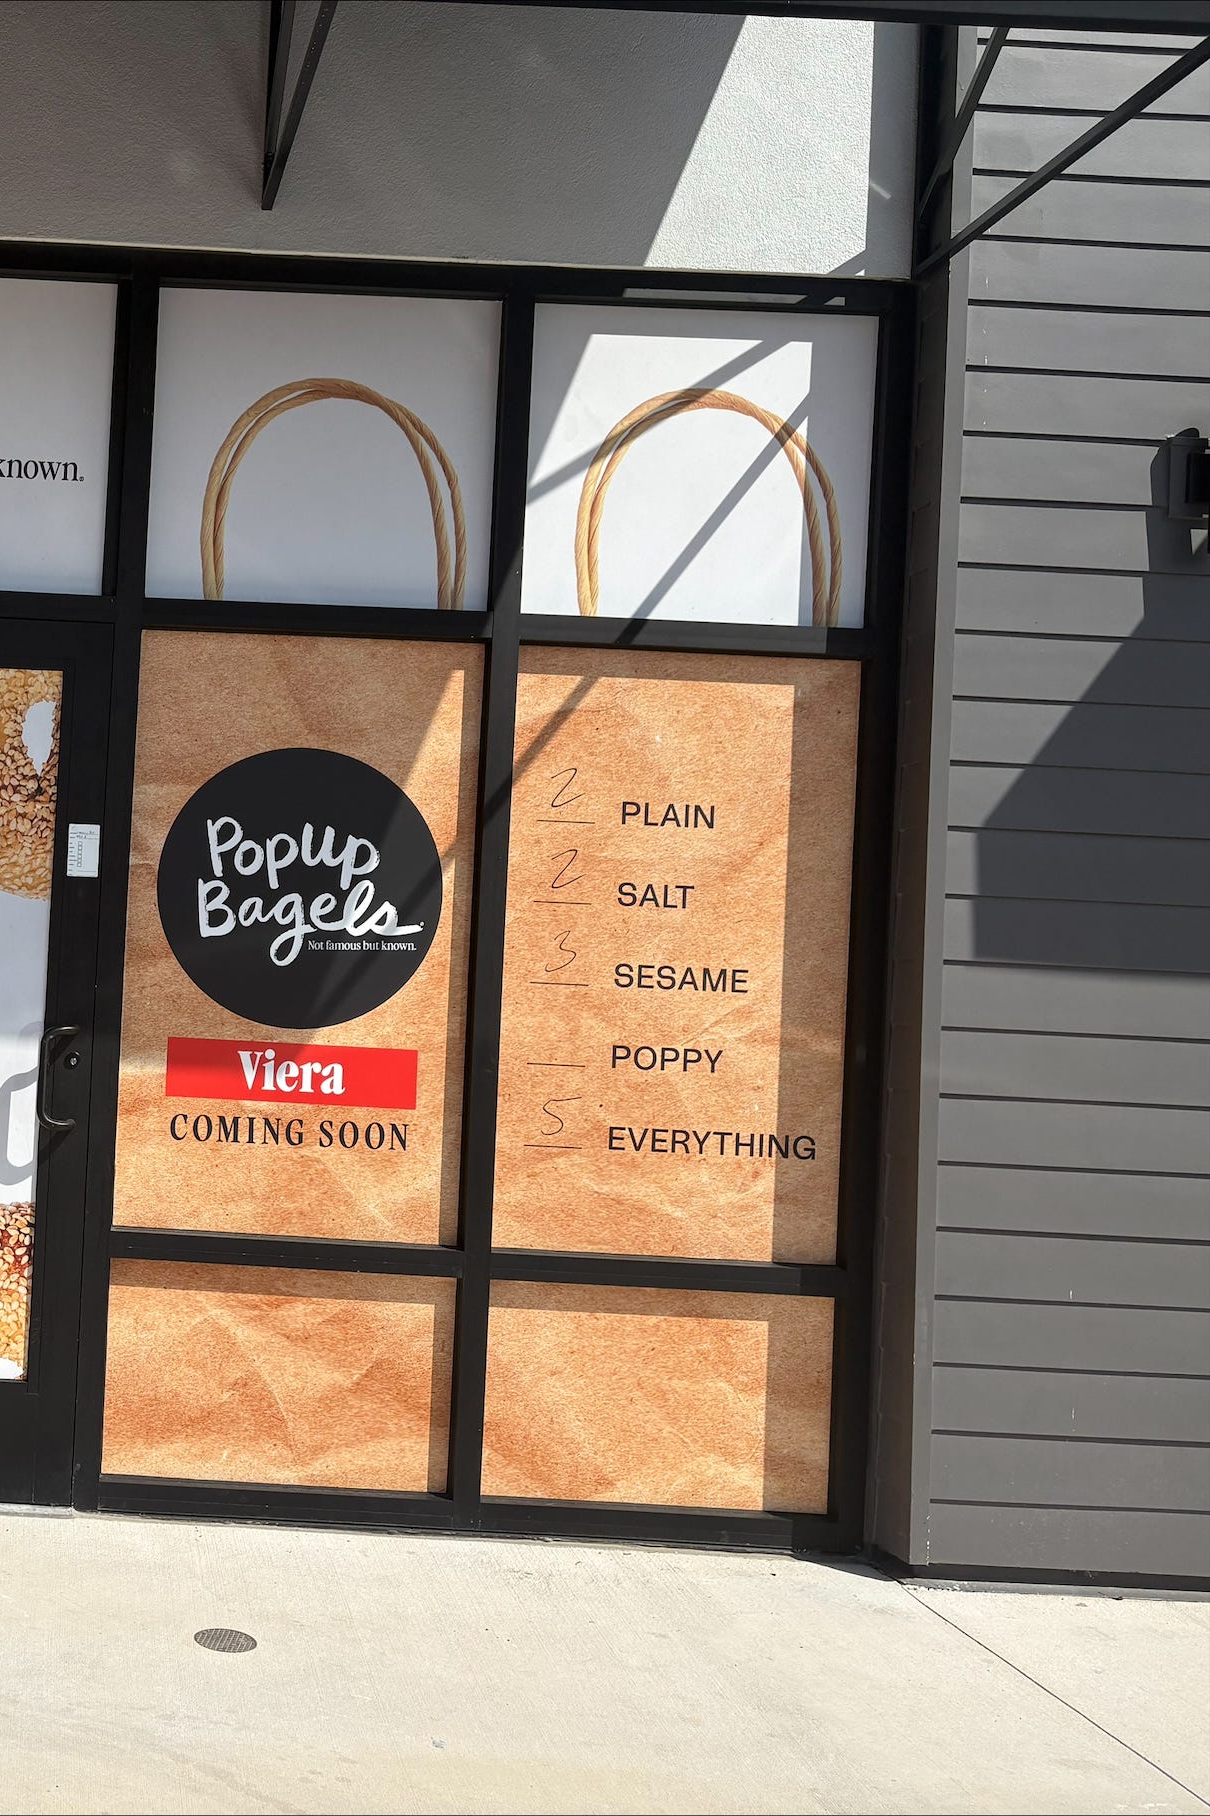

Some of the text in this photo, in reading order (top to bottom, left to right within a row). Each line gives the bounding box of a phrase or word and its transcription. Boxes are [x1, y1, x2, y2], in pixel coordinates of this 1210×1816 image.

[550, 767, 716, 829] 2 PLAIN
[550, 849, 695, 909] 2 SALT
[308, 940, 417, 951] Not famous but known.
[544, 930, 749, 993] 3 SESAME
[237, 1048, 346, 1095] Viera
[611, 1045, 724, 1074] POPPY
[170, 1113, 410, 1151] COMING SOON
[540, 1096, 817, 1160] 5 EVERYTHING
